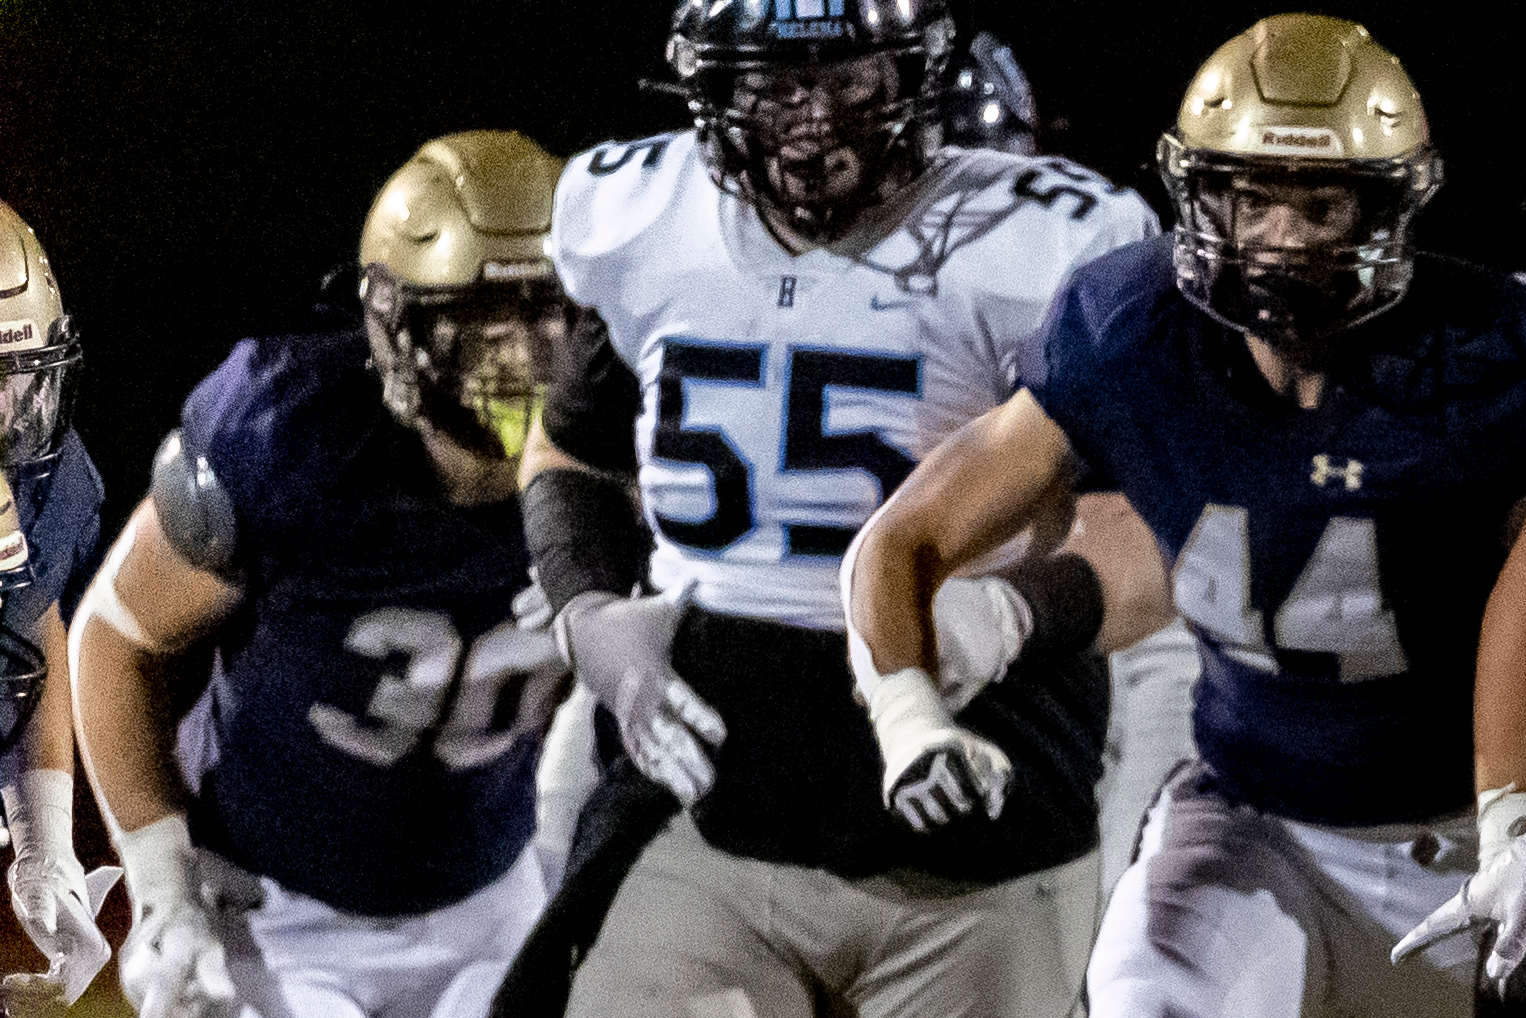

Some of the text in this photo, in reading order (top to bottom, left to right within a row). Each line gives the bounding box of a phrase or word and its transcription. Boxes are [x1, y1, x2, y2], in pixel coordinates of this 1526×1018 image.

[0, 323, 33, 344] dell
[650, 335, 924, 564] 55
[1171, 502, 1408, 684] 44
[306, 606, 572, 770] 30
